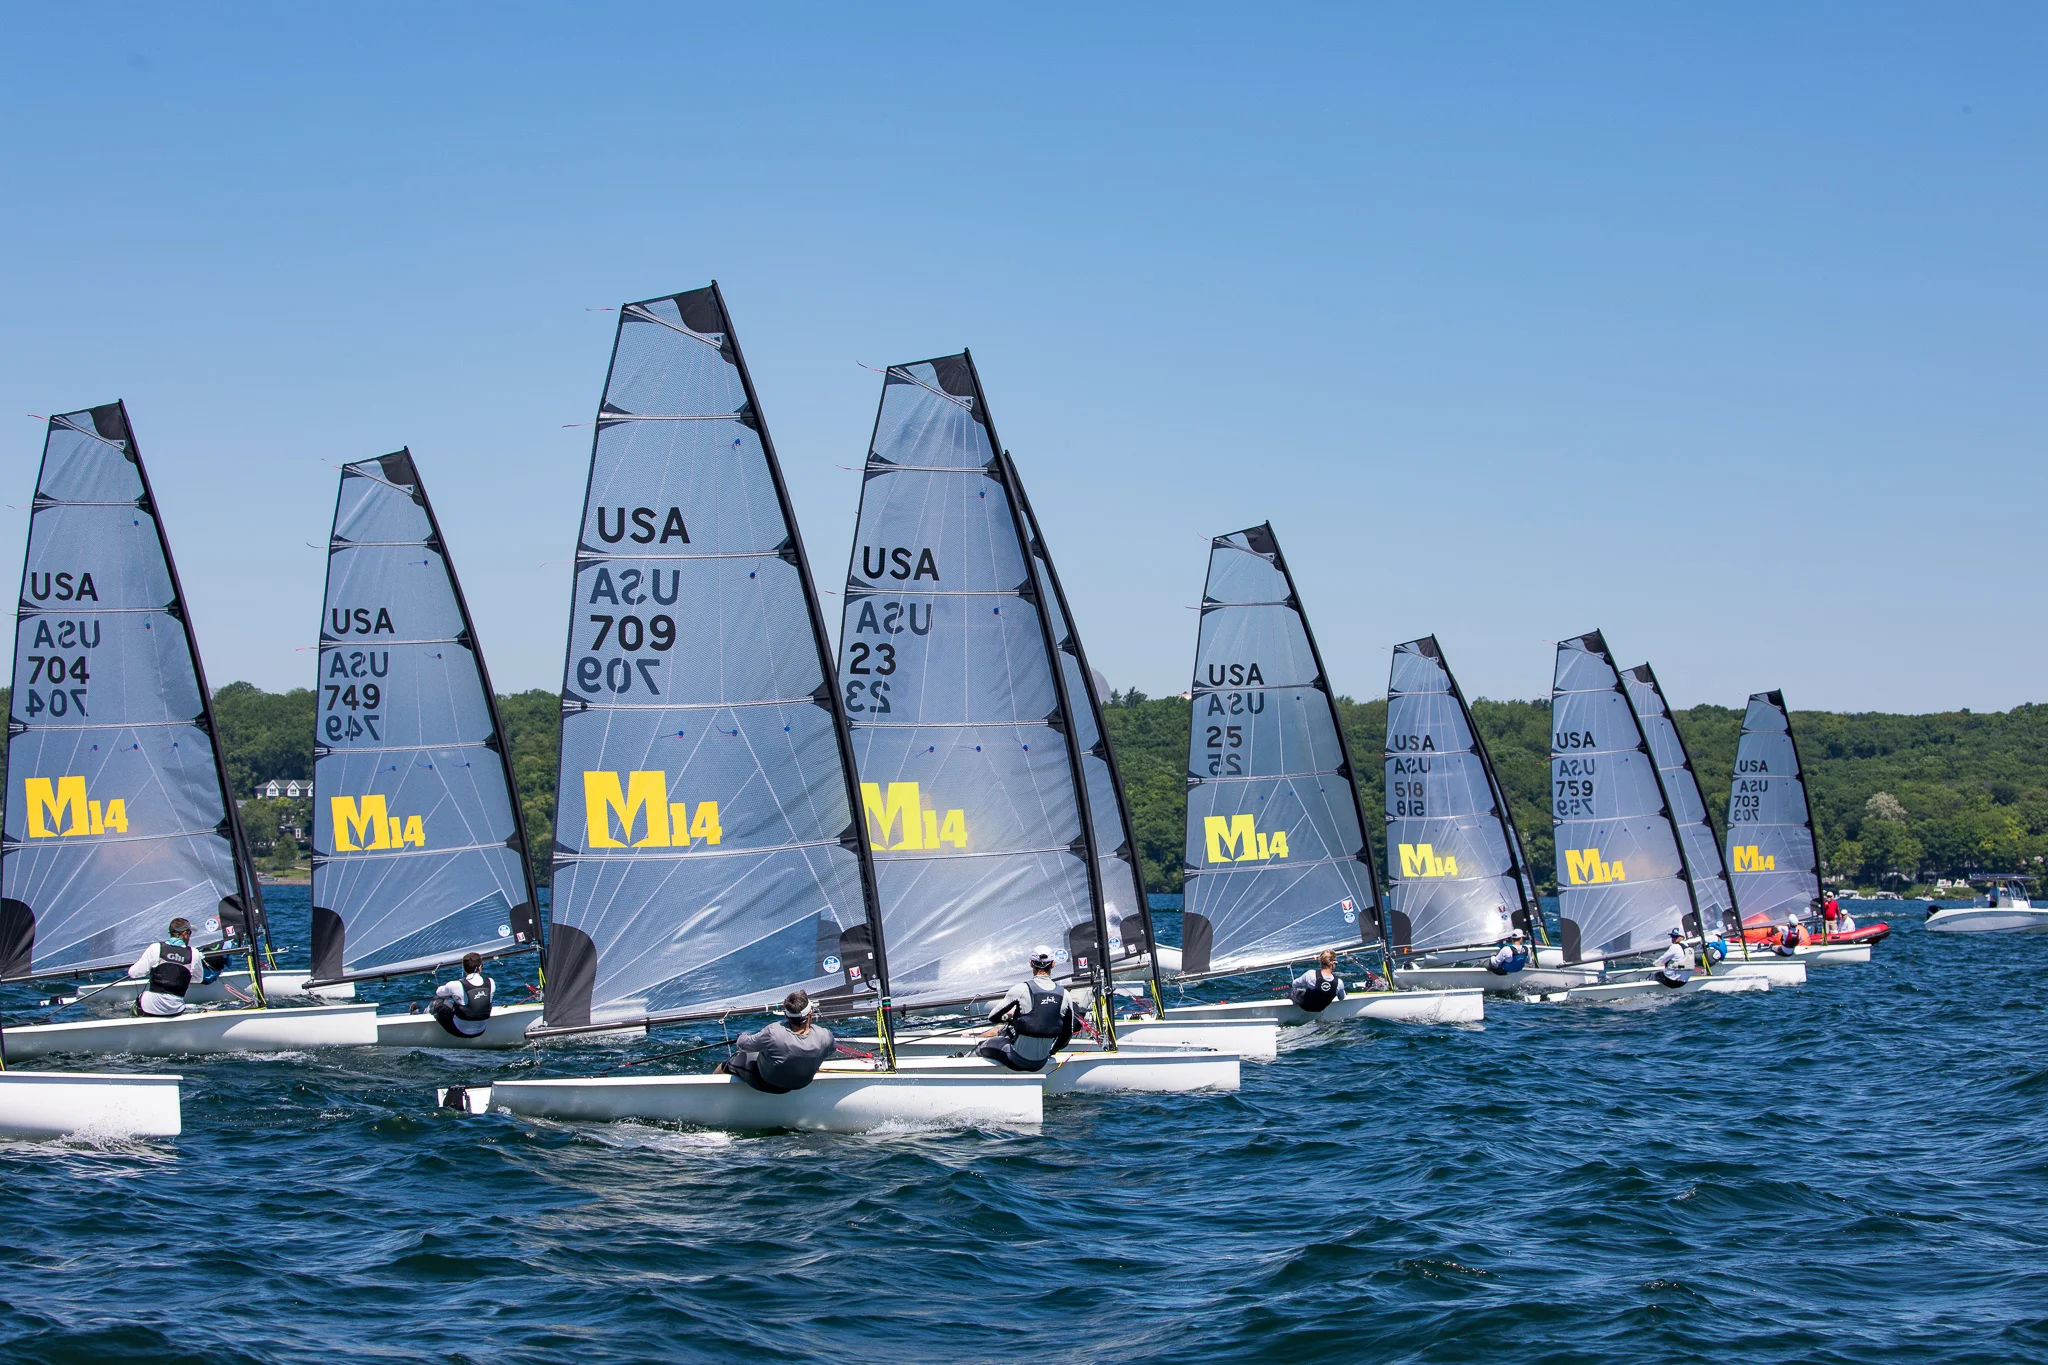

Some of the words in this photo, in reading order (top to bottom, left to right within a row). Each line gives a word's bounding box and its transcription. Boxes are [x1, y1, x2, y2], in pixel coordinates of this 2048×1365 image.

[597, 506, 691, 544] USA
[862, 545, 940, 581] USA
[31, 572, 99, 601] USA
[332, 607, 395, 634] USA
[590, 614, 676, 652] 709
[28, 656, 90, 685] 704
[849, 642, 897, 676] 23
[1208, 663, 1265, 687] USA
[324, 683, 381, 711] 749
[1206, 725, 1242, 748] 25
[1394, 734, 1435, 751] USA
[1556, 731, 1596, 749] USA
[1739, 760, 1769, 773] USA
[1394, 781, 1424, 798] 518
[1555, 780, 1593, 798] 759
[1733, 795, 1760, 808] 703
